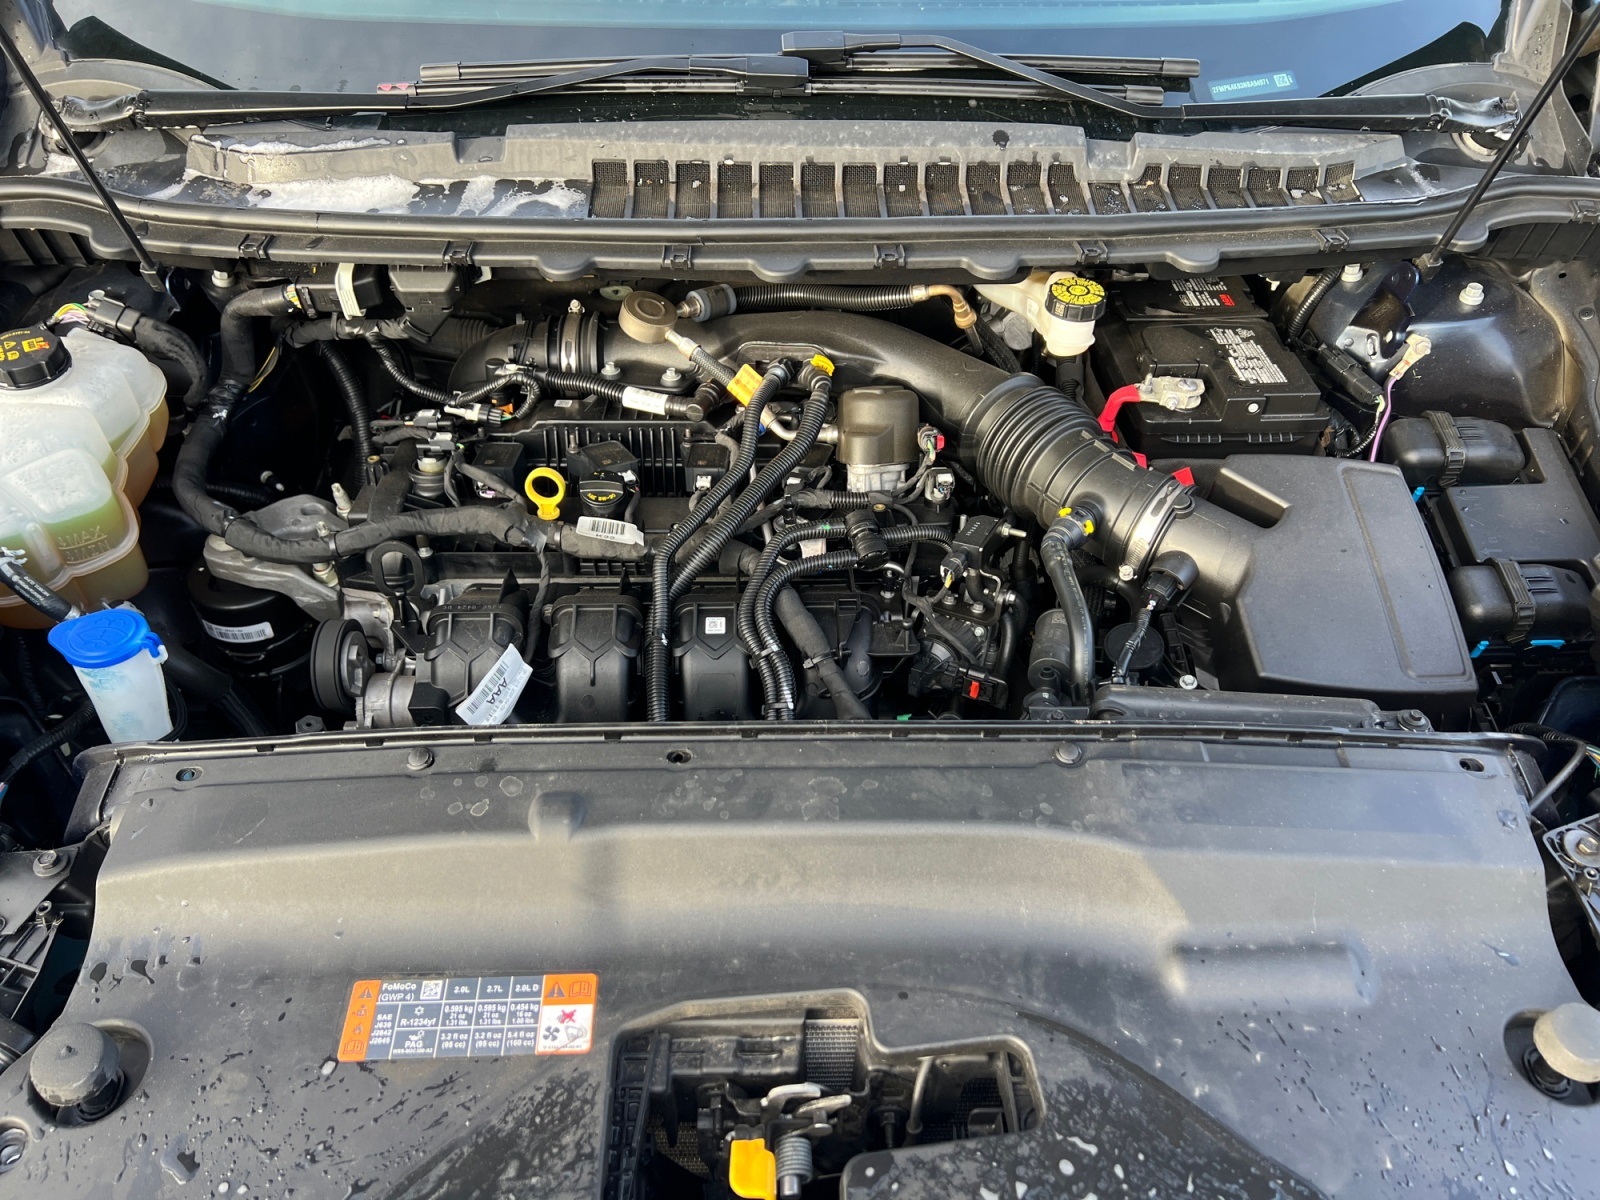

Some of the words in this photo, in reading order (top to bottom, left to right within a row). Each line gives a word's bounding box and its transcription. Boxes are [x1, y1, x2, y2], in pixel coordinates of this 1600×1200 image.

[382, 982, 417, 991] FoMoCo
[453, 986, 470, 994] 2.0L
[486, 985, 503, 993] 2.7L
[515, 984, 531, 992] 2.0L
[533, 983, 539, 992] D
[378, 993, 403, 1002] (GWP
[405, 992, 415, 1001] 4)
[444, 1005, 463, 1013] 0.595
[464, 1005, 473, 1014] kg
[477, 1004, 496, 1012] 0.595
[497, 1003, 507, 1014] kg
[530, 1002, 539, 1013] kg
[376, 1013, 393, 1021] SAE
[400, 1018, 436, 1027] R-1234yf
[474, 1032, 486, 1040] 3.2
[404, 1040, 424, 1048] PAG
[488, 1039, 500, 1047] cc)
[523, 1038, 535, 1047] cc)
